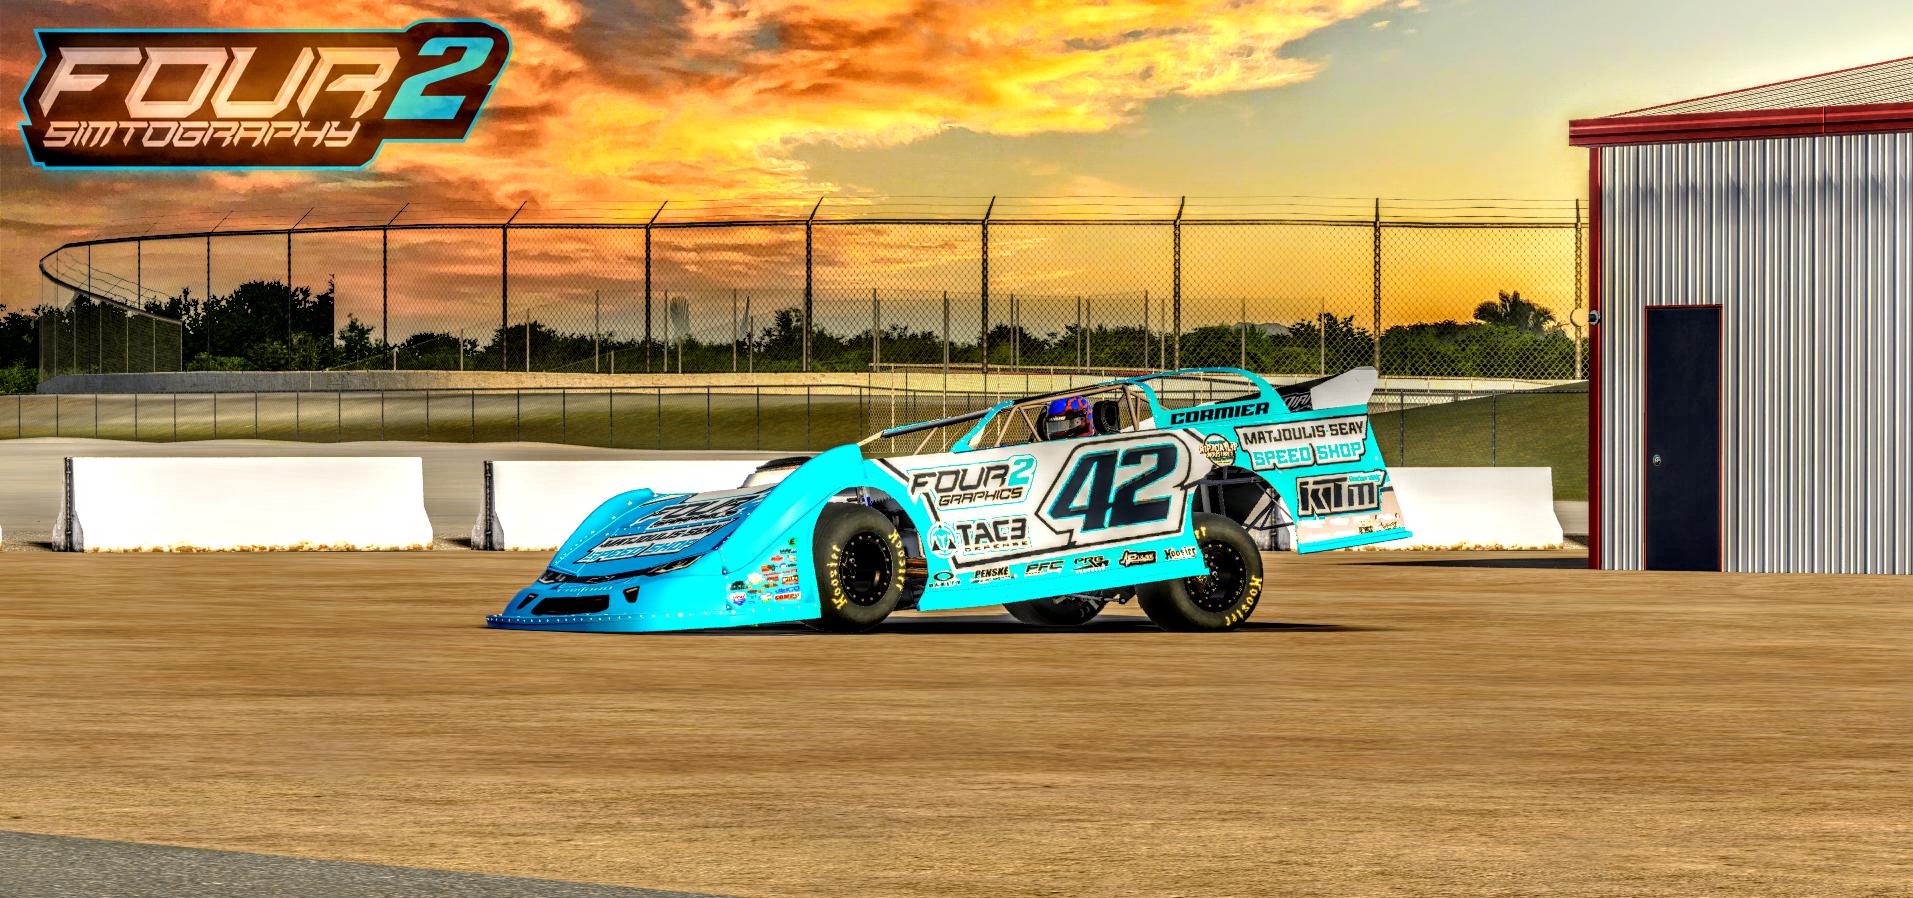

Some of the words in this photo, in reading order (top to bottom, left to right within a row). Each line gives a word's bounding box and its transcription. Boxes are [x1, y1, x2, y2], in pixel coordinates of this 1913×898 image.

[1171, 402, 1270, 425] CORMIER
[1253, 447, 1312, 466] SPEED
[1316, 442, 1362, 460] SHOP
[938, 487, 1024, 507] GRAPHICS
[1049, 442, 1179, 533] 42
[956, 518, 1027, 546] TAC3
[973, 566, 1009, 579] PENSKE
